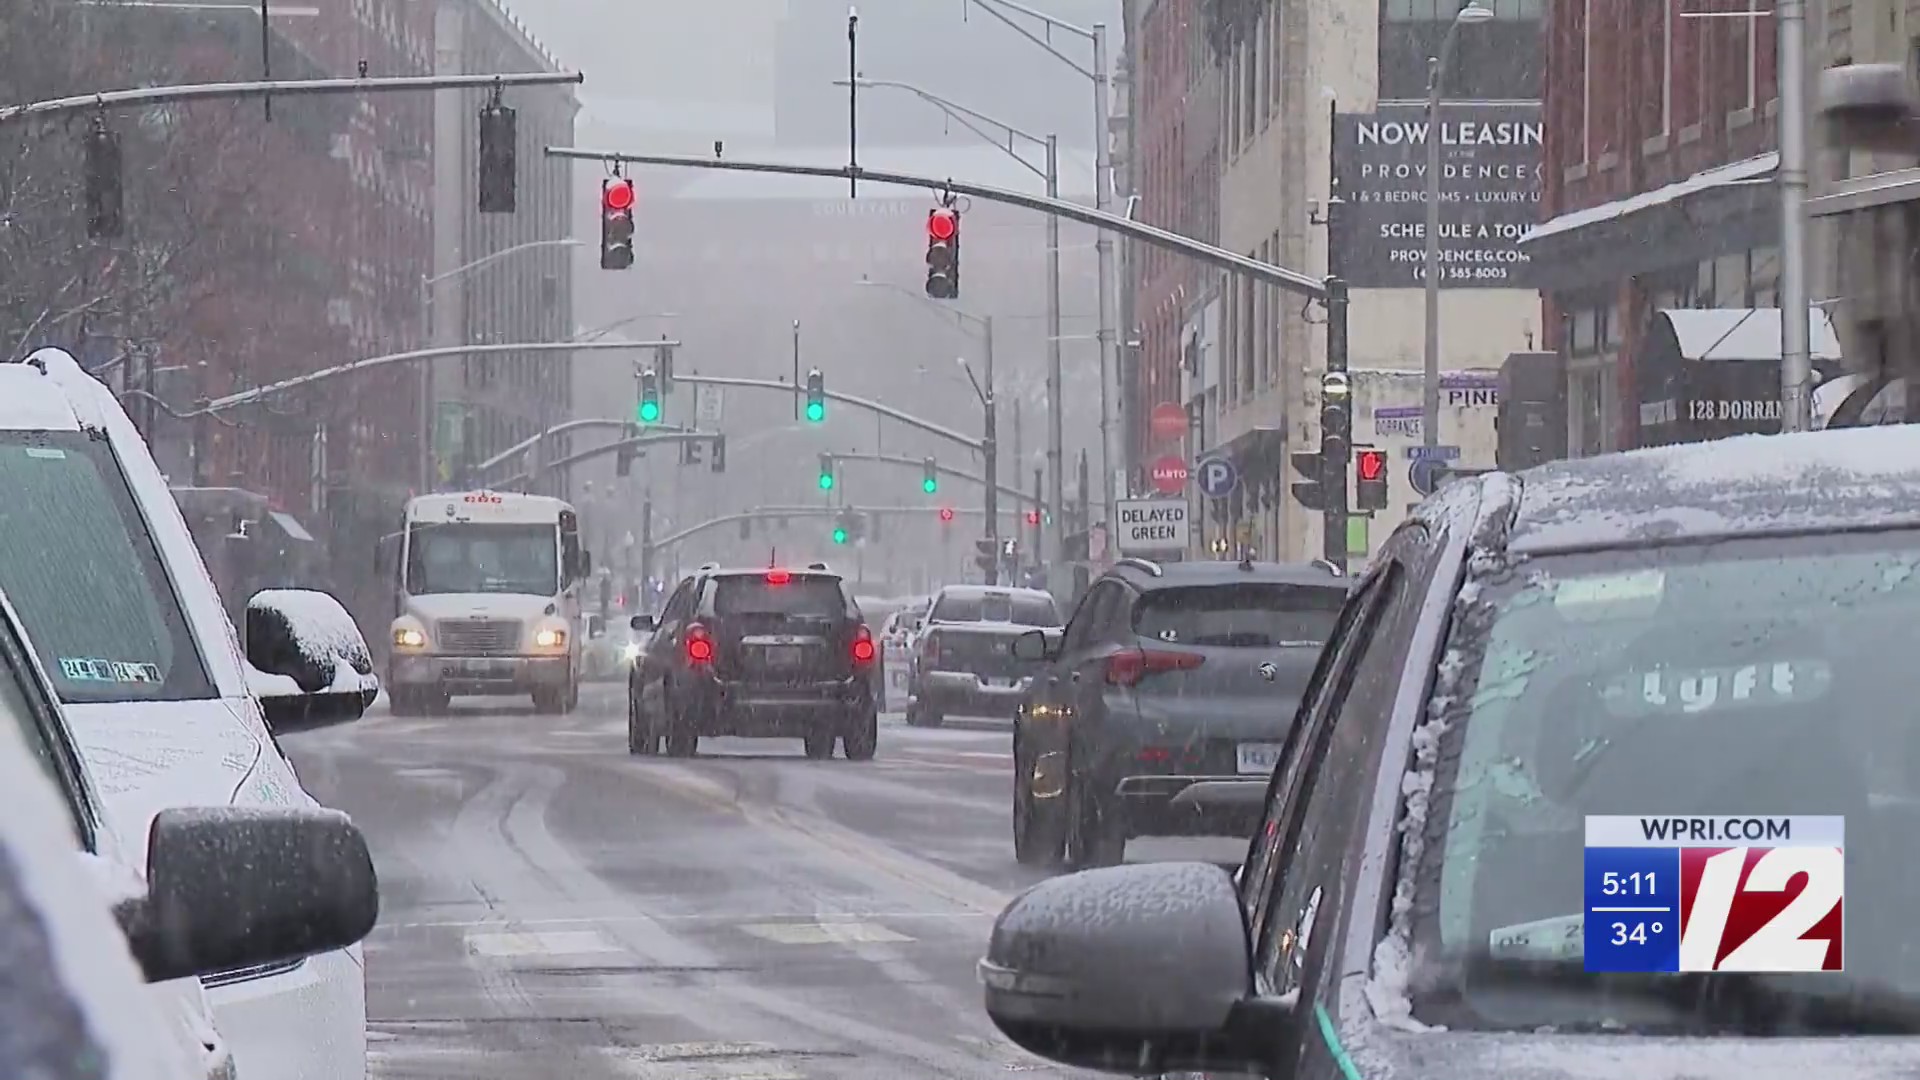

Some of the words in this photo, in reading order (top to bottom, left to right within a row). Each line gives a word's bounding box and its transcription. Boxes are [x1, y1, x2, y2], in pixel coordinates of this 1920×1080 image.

[1358, 122, 1429, 145] NOW
[1441, 122, 1544, 145] LEASIN
[1362, 164, 1527, 178] PROVDENCE
[1475, 191, 1526, 202] LUXURY
[1380, 224, 1472, 238] SCHEULE
[1477, 224, 1489, 238] A
[1494, 224, 1531, 238] TOU
[1390, 250, 1531, 262] PROVDENCEG.COM
[1689, 400, 1714, 420] 128
[1719, 400, 1787, 420] DORRAN
[1207, 464, 1228, 492] P
[1122, 508, 1184, 523] DELAYED
[1132, 525, 1176, 540] GREEN
[1643, 661, 1794, 713] lyft
